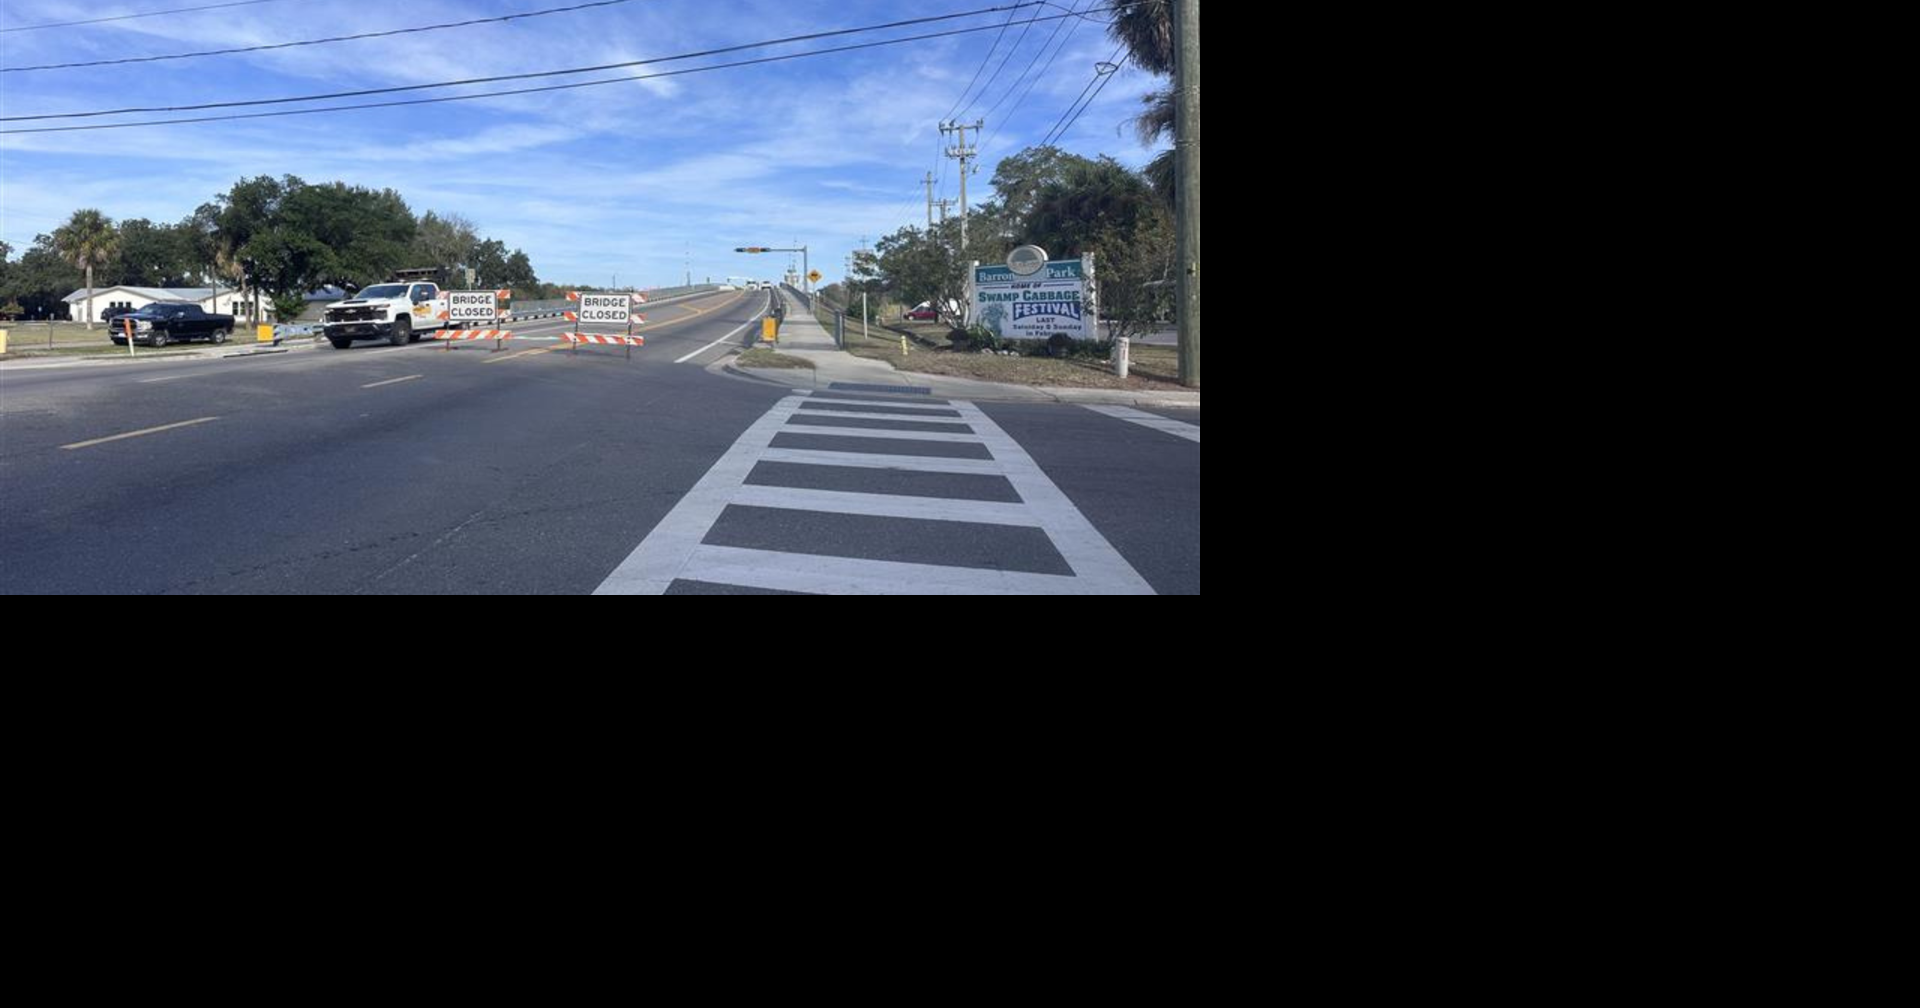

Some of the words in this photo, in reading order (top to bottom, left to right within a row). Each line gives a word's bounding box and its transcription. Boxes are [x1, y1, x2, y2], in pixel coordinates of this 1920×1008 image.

[979, 272, 1014, 281] Barron
[1046, 267, 1075, 278] Park
[452, 295, 492, 304] BRIDGE
[979, 291, 1019, 303] SWAMP
[1022, 290, 1080, 301] CABBAGE
[584, 297, 626, 307] BRIDGE
[451, 307, 493, 317] CLOSED
[581, 310, 627, 320] CLOSED
[1014, 303, 1079, 318] FESTIVAL
